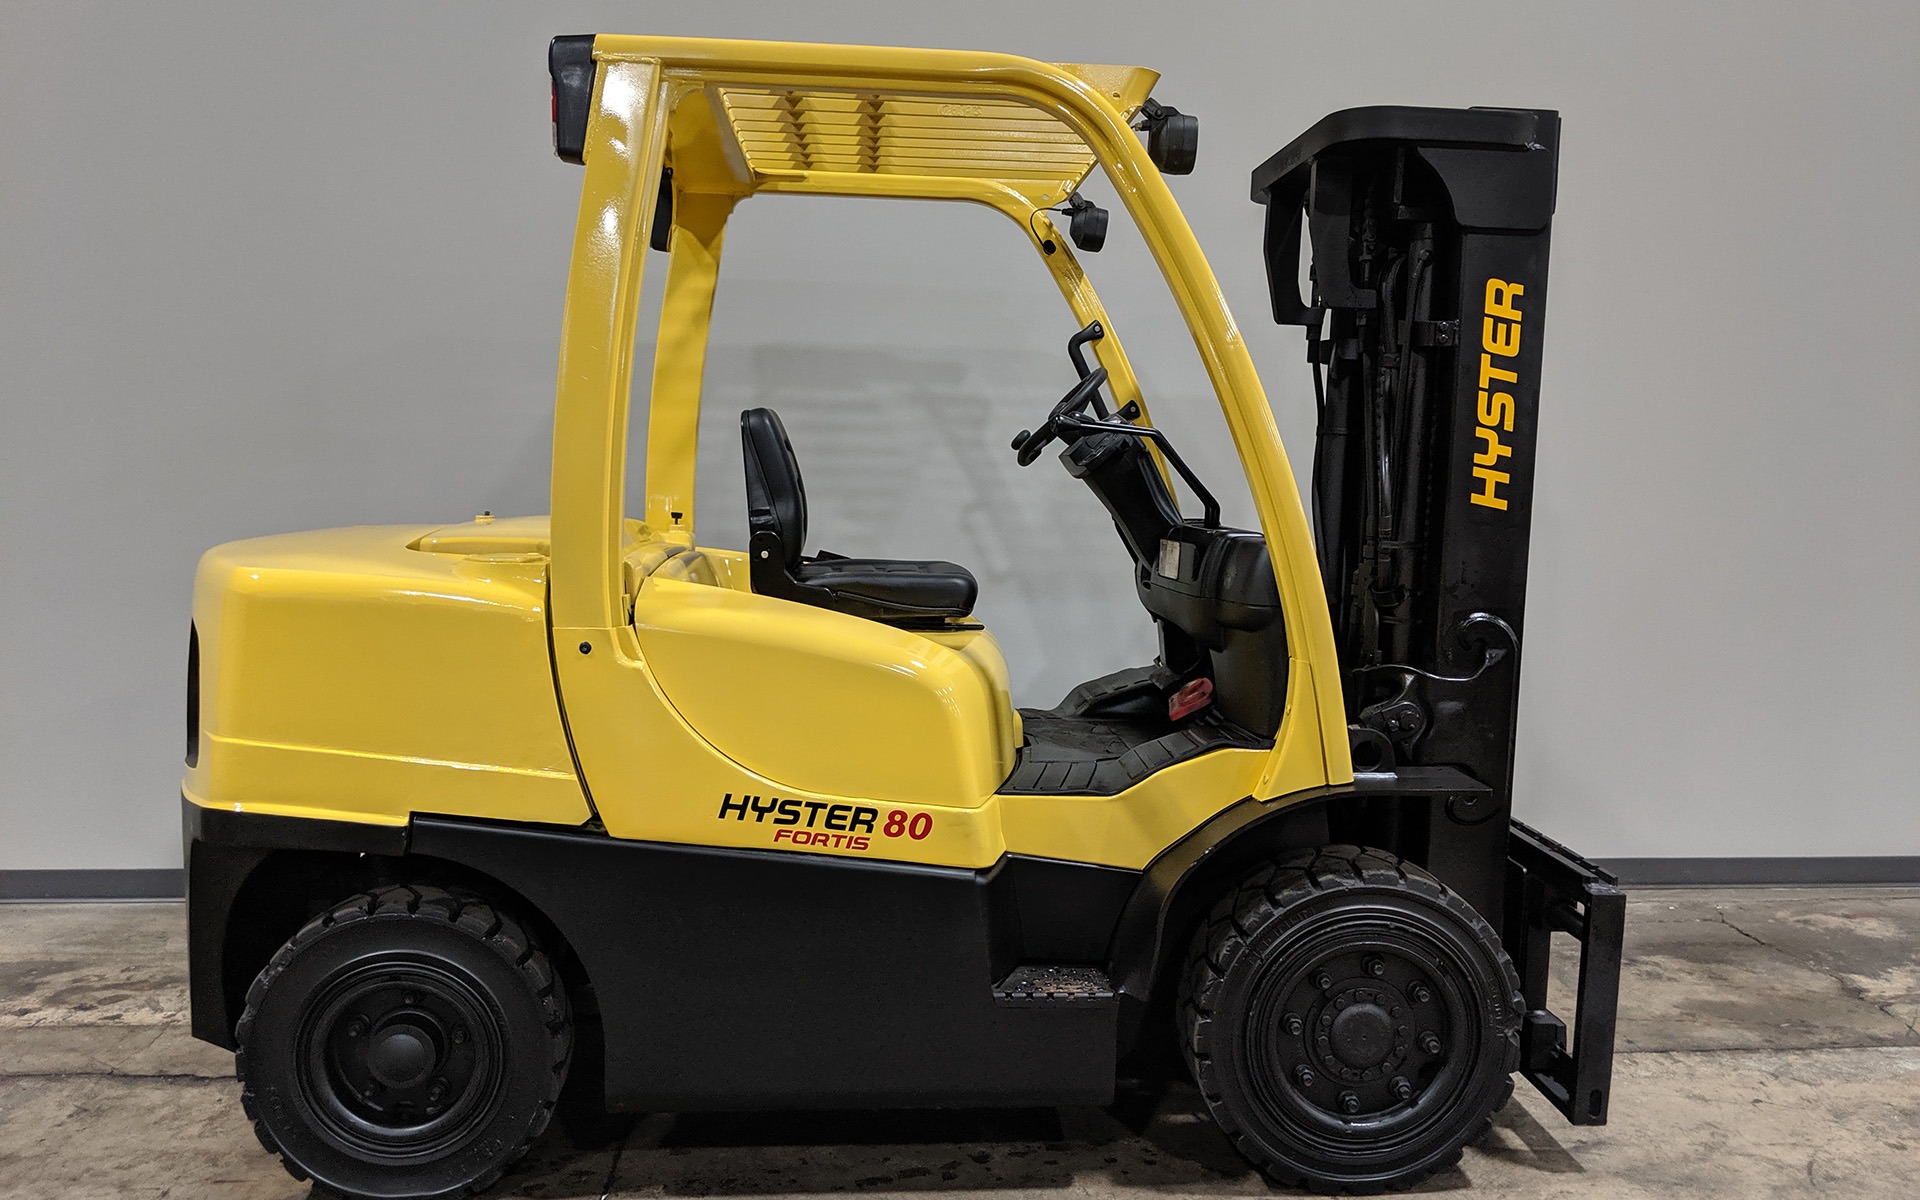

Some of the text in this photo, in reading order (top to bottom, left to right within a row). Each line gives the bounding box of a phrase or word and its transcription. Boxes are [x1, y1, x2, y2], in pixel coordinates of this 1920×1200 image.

[1470, 278, 1525, 511] HYSTER
[718, 792, 933, 841] HYSTER 80
[773, 829, 871, 851] FORTIS
